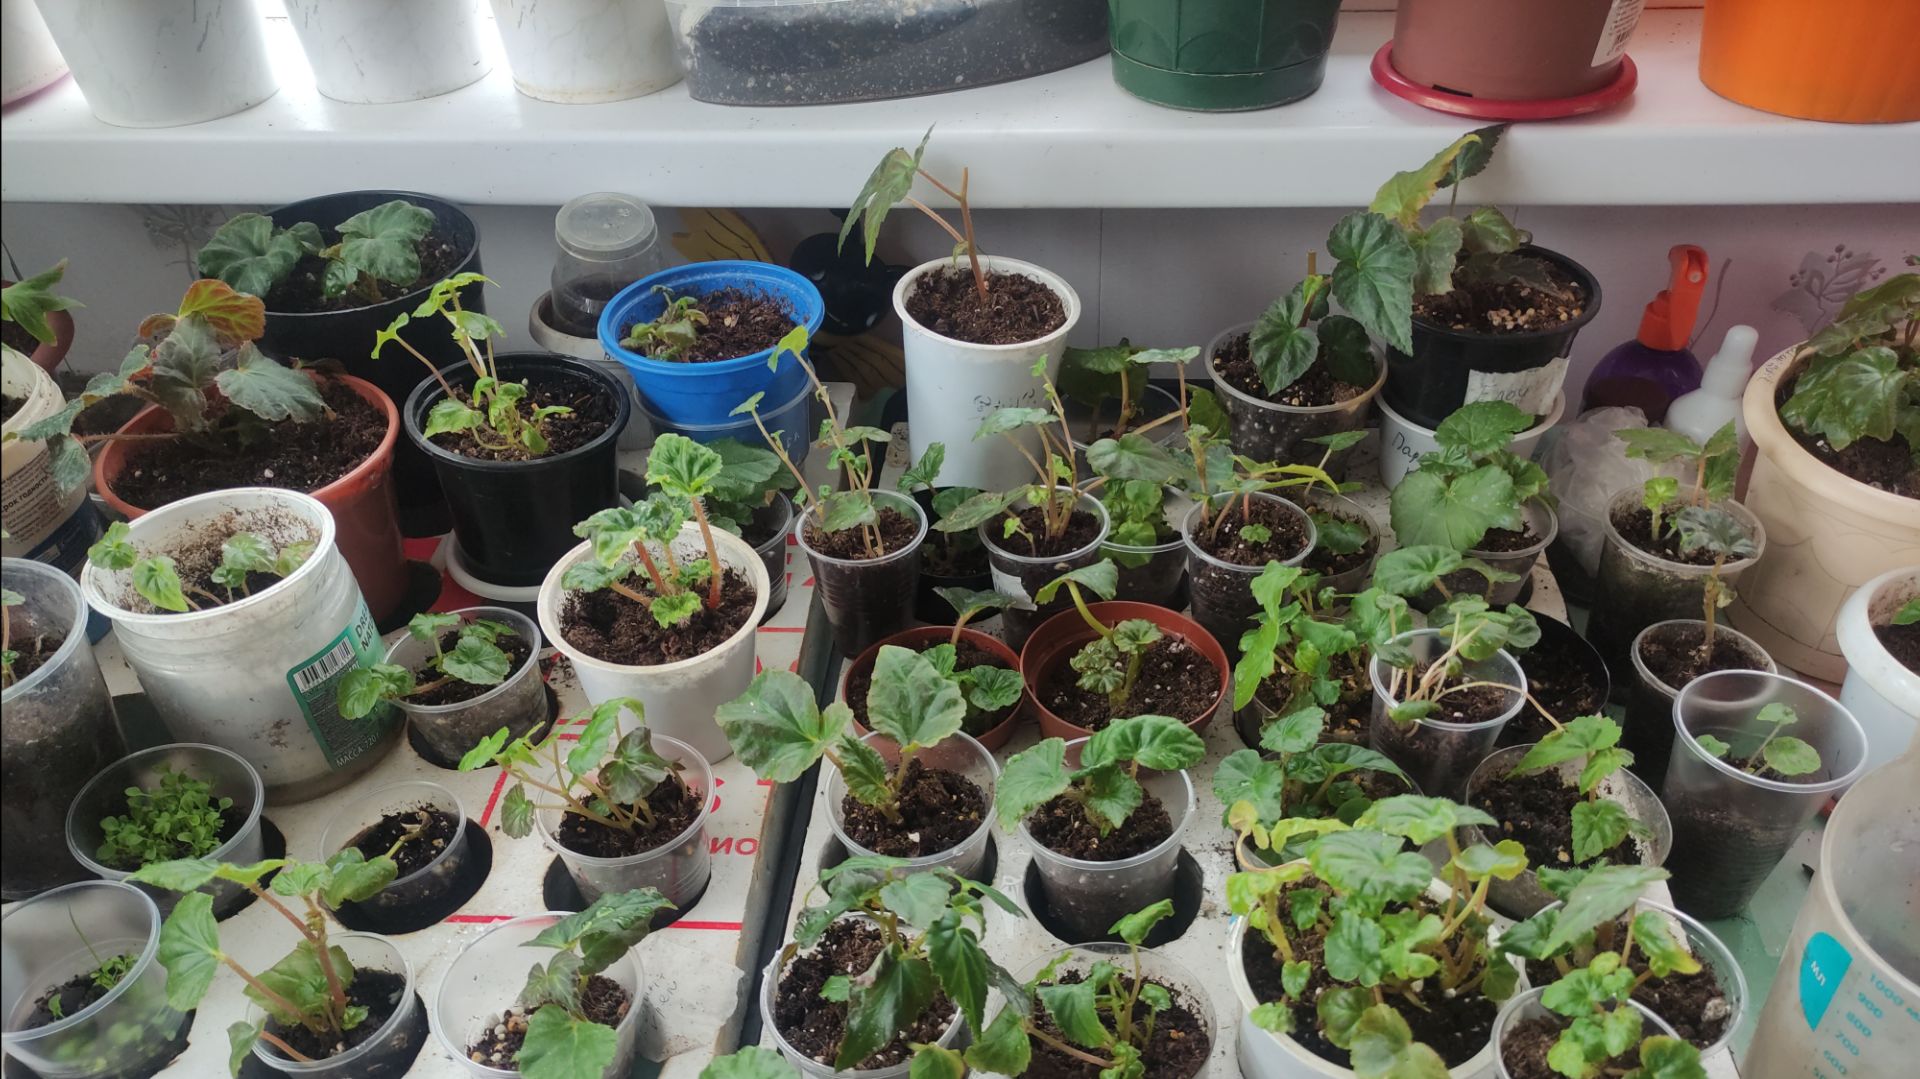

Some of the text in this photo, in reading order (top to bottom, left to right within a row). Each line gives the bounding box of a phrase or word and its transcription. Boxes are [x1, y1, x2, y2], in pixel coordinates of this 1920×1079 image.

[1870, 972, 1904, 1007] 1000
[1858, 991, 1883, 1019] 900
[1835, 1030, 1860, 1057] 700
